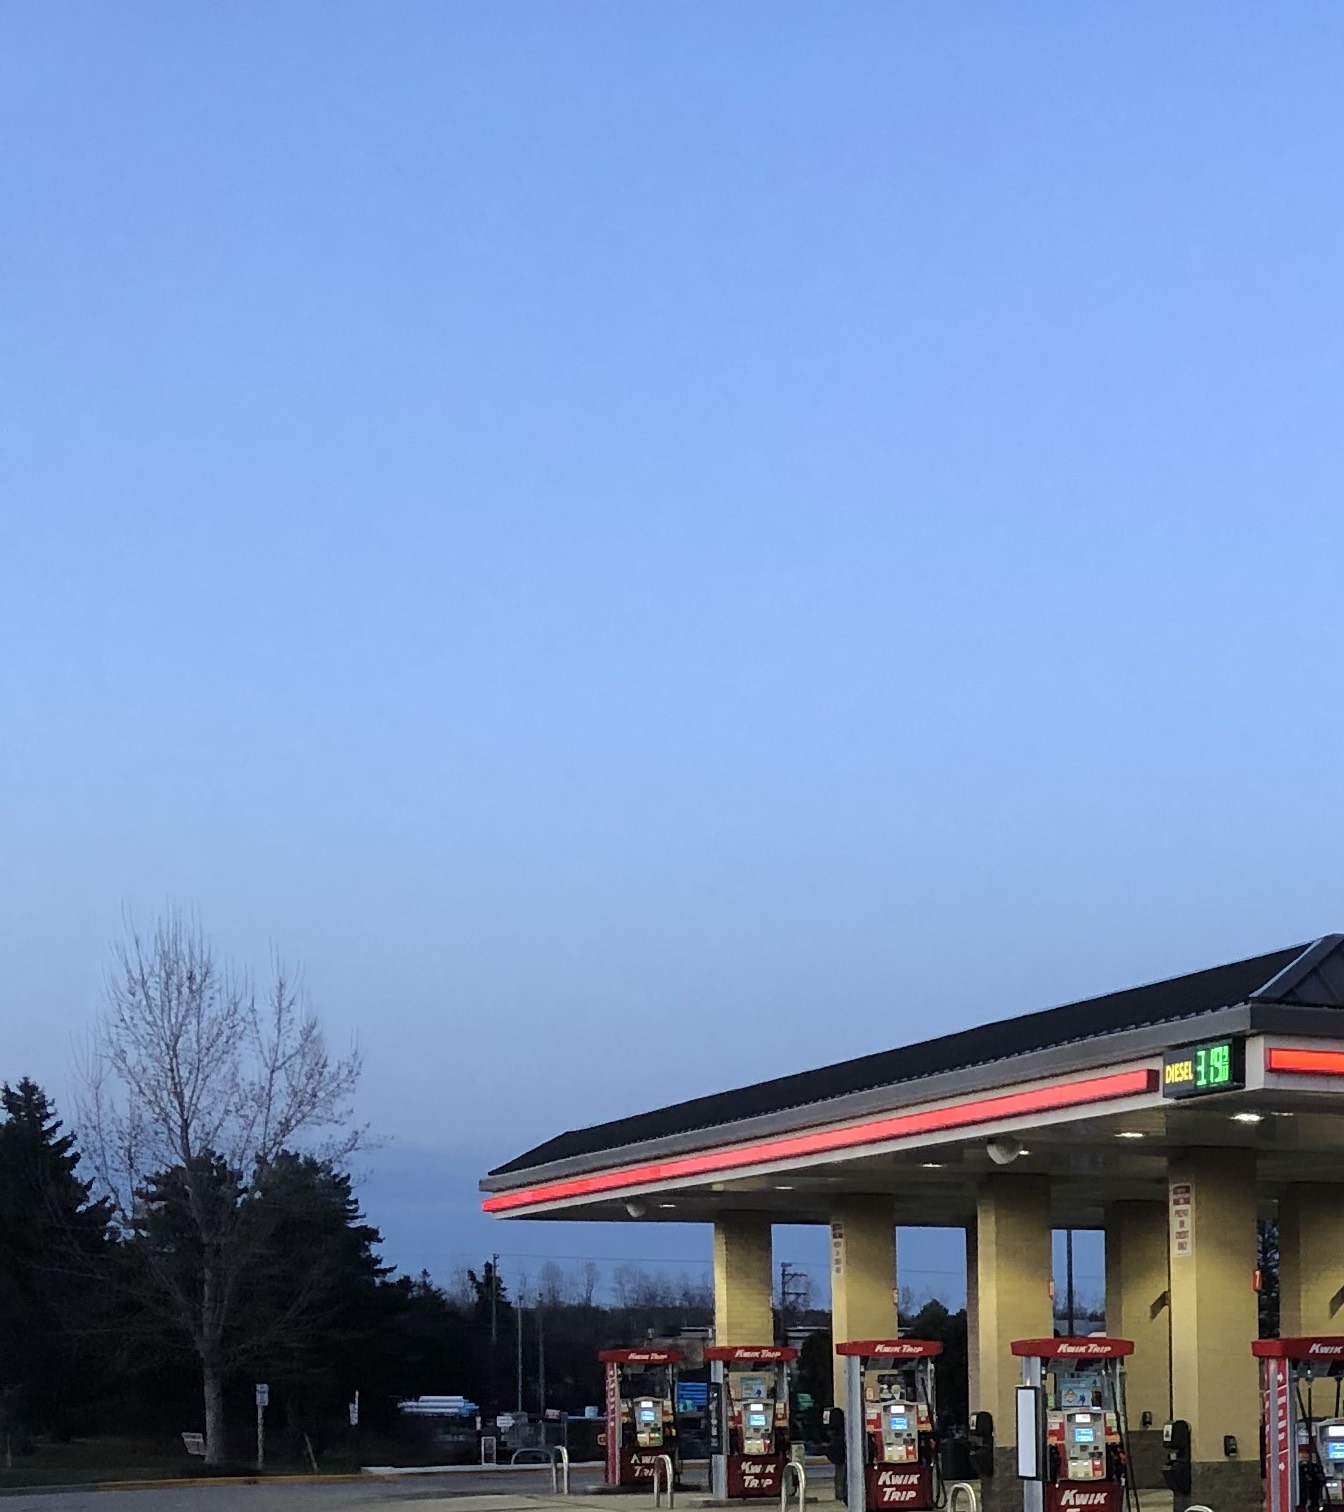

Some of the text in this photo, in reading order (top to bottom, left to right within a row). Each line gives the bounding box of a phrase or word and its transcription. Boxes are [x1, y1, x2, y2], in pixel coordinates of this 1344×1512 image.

[1165, 1060, 1194, 1085] DIESEL
[734, 1349, 782, 1358] KWIK TRIP
[874, 1344, 924, 1353] KWIK TRIP
[1057, 1343, 1112, 1354] KWIK TRIP
[1309, 1343, 1343, 1354] KWIK
[877, 1470, 920, 1486] KWIK
[882, 1487, 917, 1502] TRIP
[1060, 1489, 1108, 1506] KWIK
